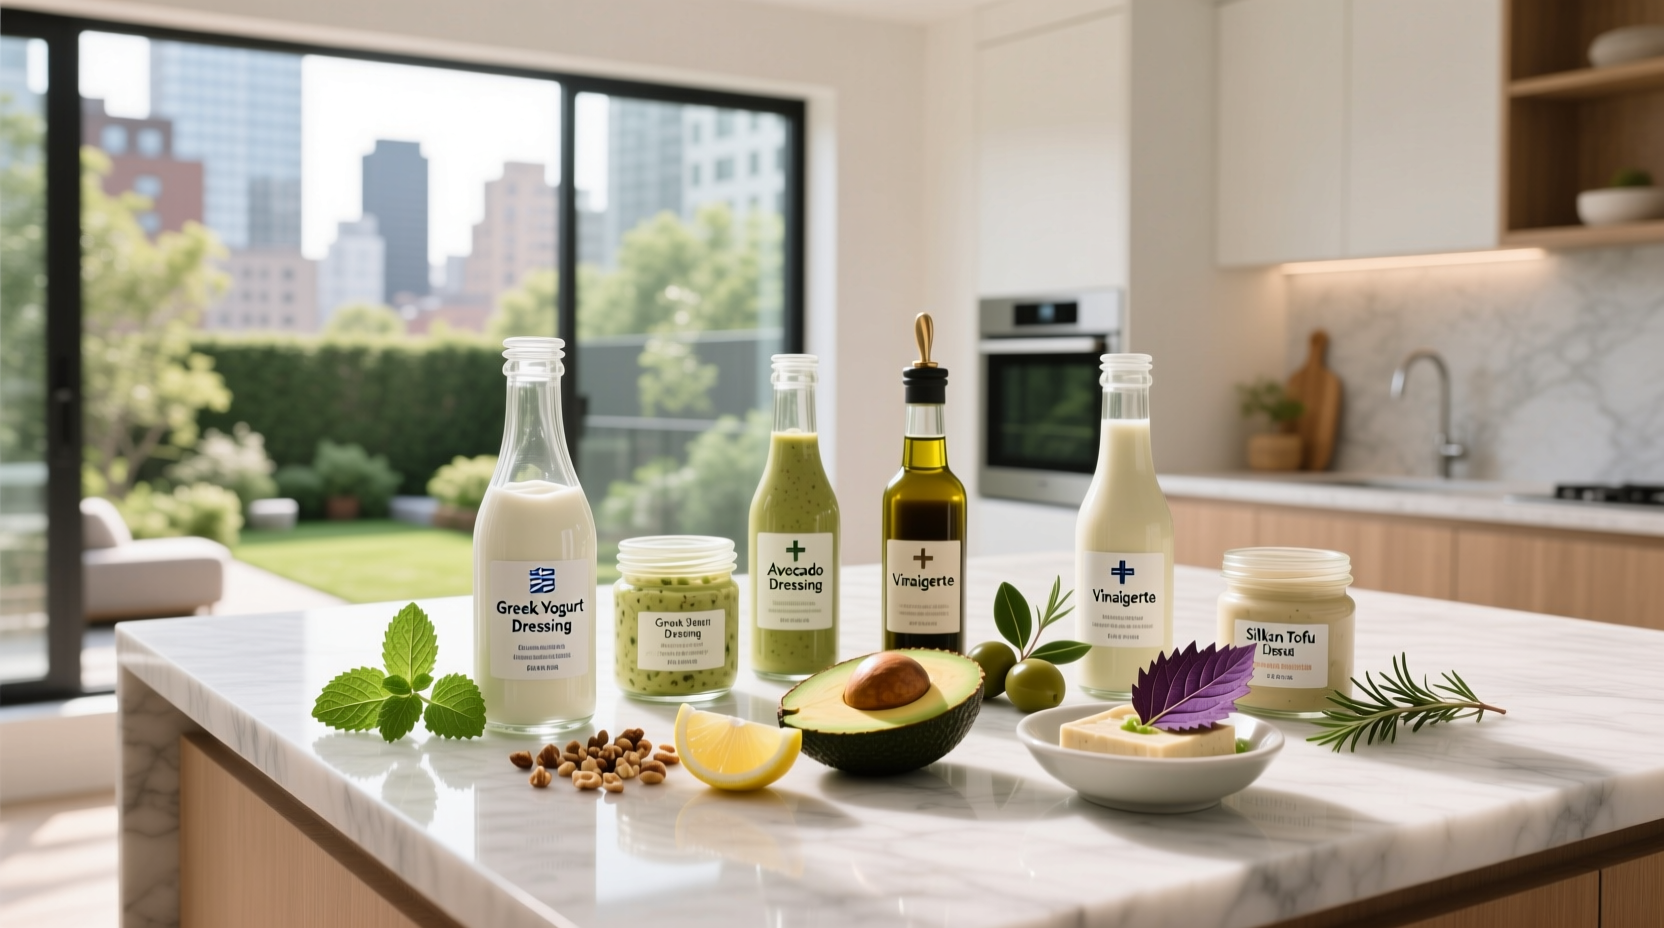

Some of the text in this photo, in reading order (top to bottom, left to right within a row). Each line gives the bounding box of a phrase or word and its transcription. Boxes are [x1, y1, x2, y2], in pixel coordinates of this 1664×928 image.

[769, 578, 822, 594] Dressing
[1092, 588, 1156, 607] Vinaigerte
[496, 598, 584, 618] Greek Yogurt
[512, 618, 572, 635] Dressing
[1287, 630, 1316, 644] Tofu
